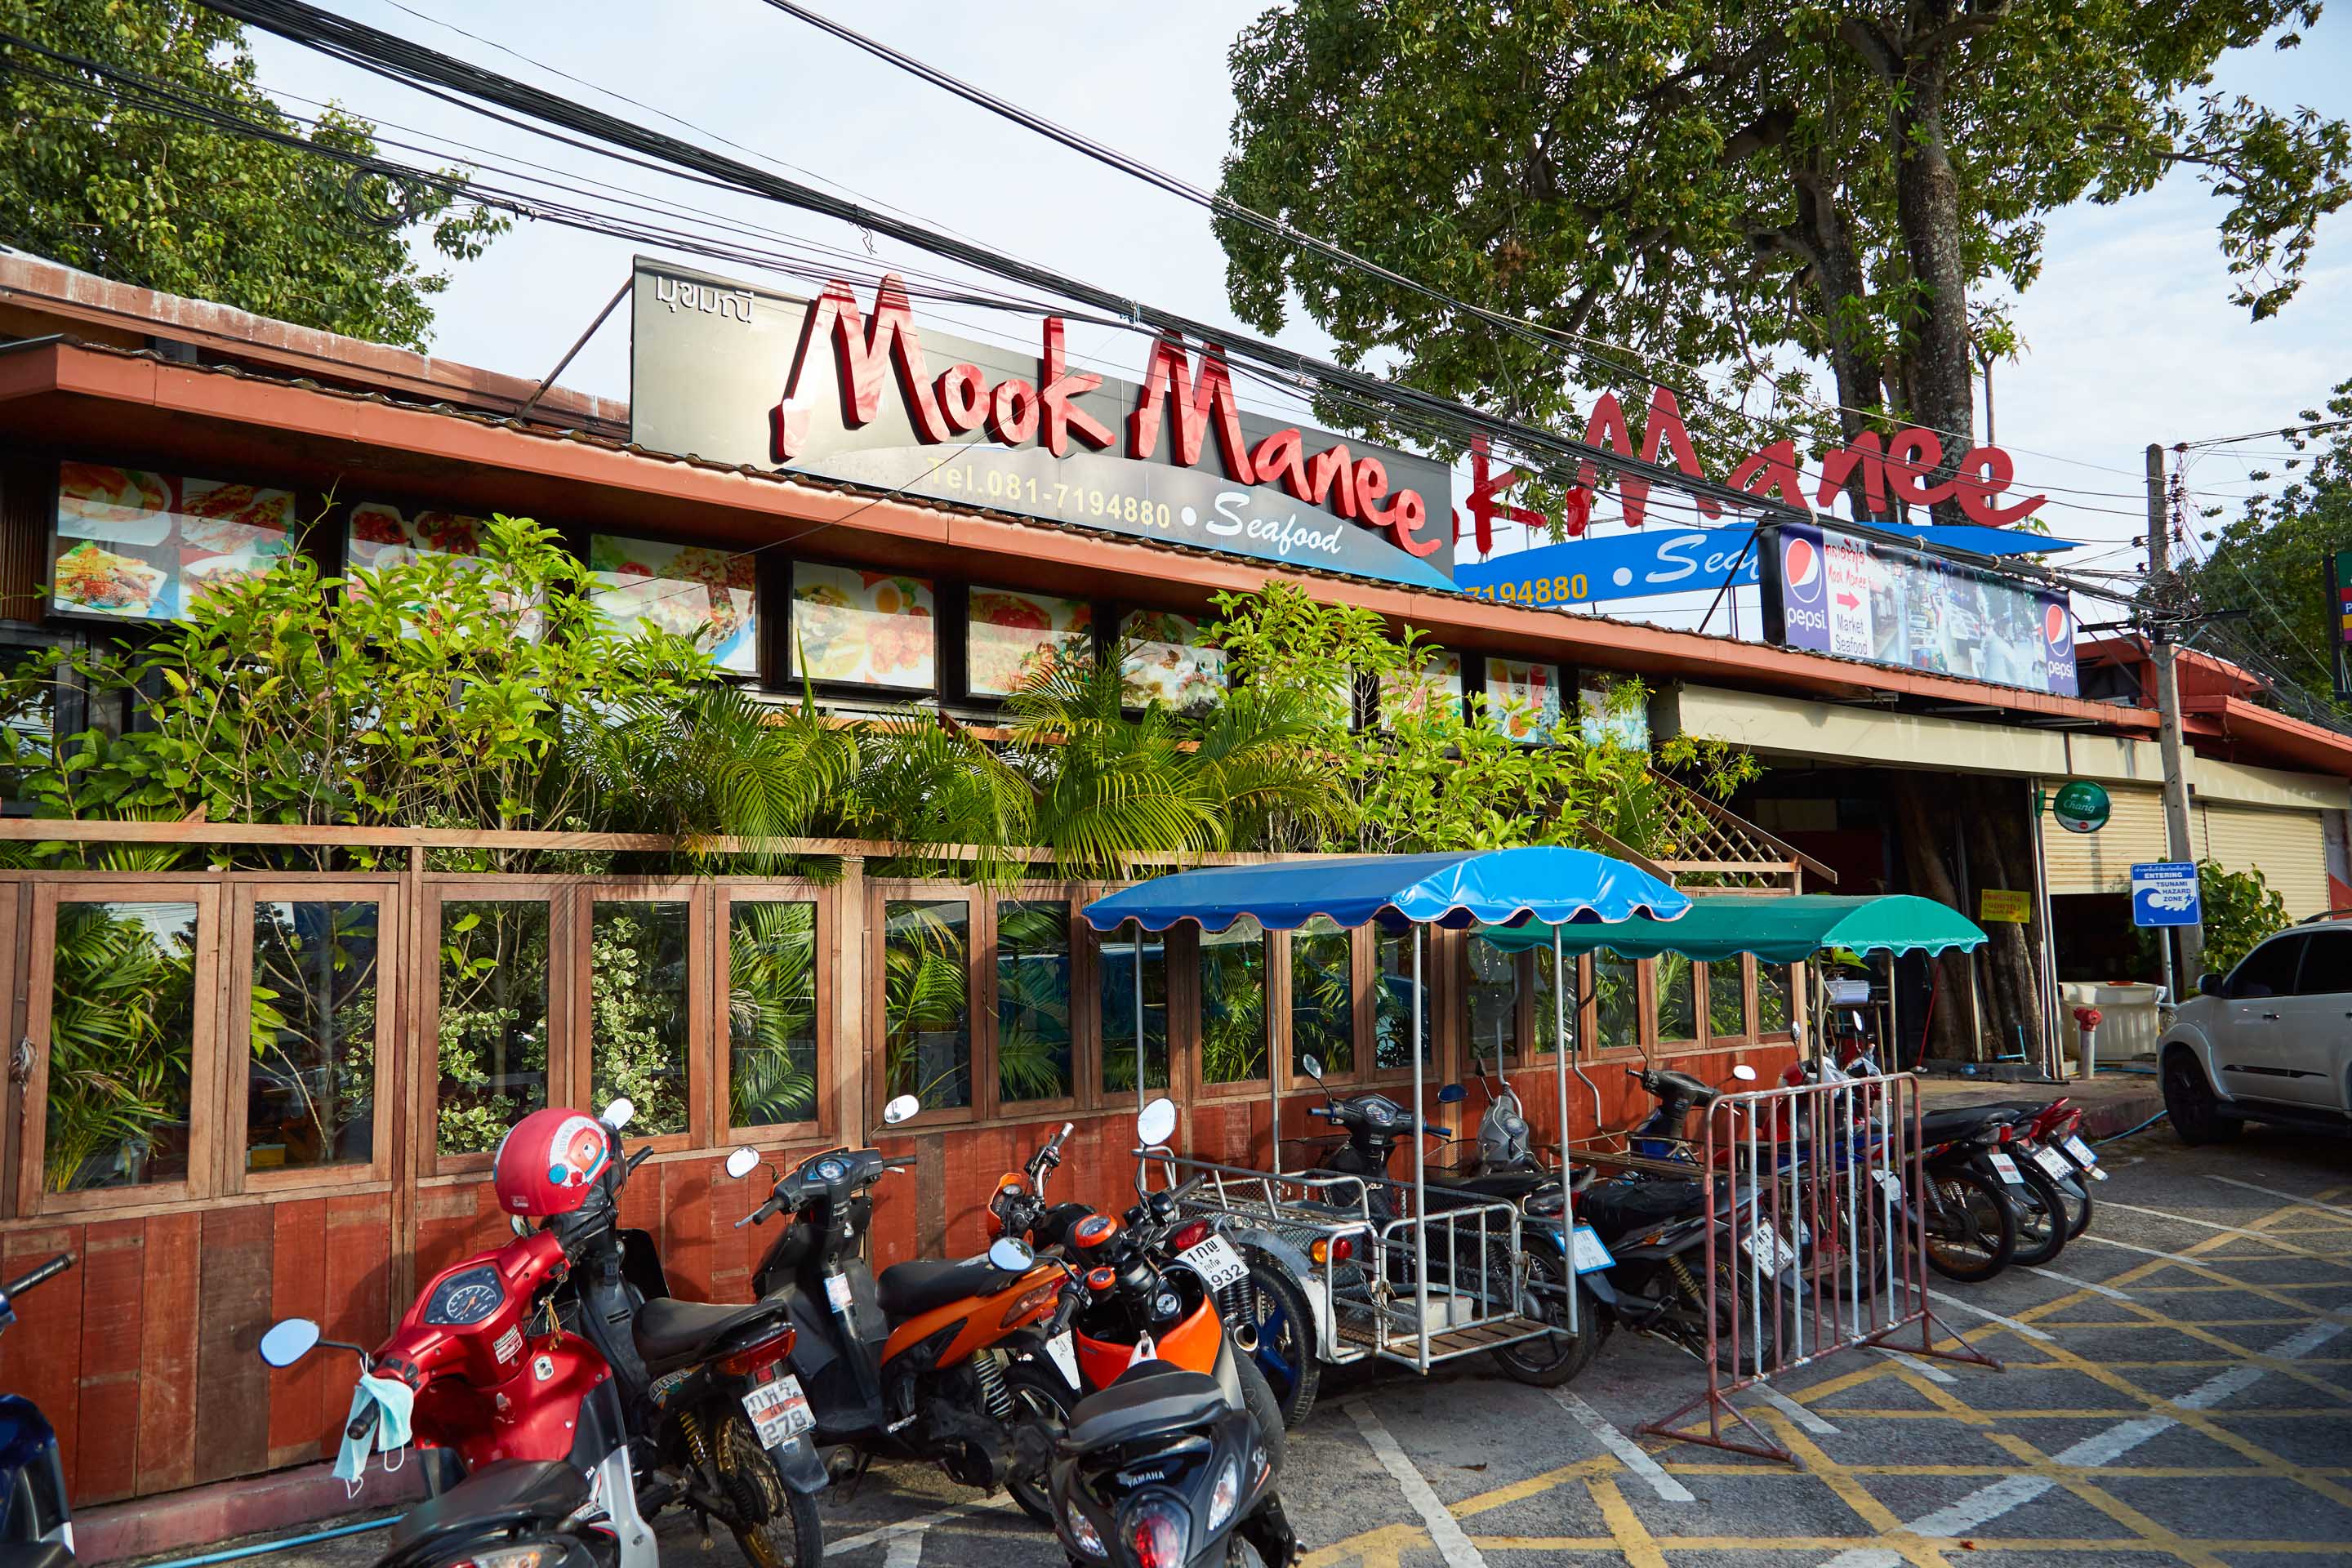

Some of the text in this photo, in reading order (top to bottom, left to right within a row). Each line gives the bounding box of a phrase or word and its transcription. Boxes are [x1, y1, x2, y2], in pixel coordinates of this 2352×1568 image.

[656, 275, 755, 324] มุขมณี
[770, 273, 1116, 463] Mook
[1130, 329, 1441, 557] Manee
[1567, 387, 2046, 537] Manee
[1205, 492, 1343, 556] Seafood
[1787, 607, 1825, 631] pepsi
[1837, 613, 1864, 635] Market
[1835, 635, 1868, 655] Seafood
[2048, 660, 2074, 680] pepsi
[2063, 799, 2096, 815] Chang
[2144, 871, 2183, 880] ENTERING
[762, 1410, 806, 1441] 278
[1127, 1470, 1165, 1489] YAMAHA
